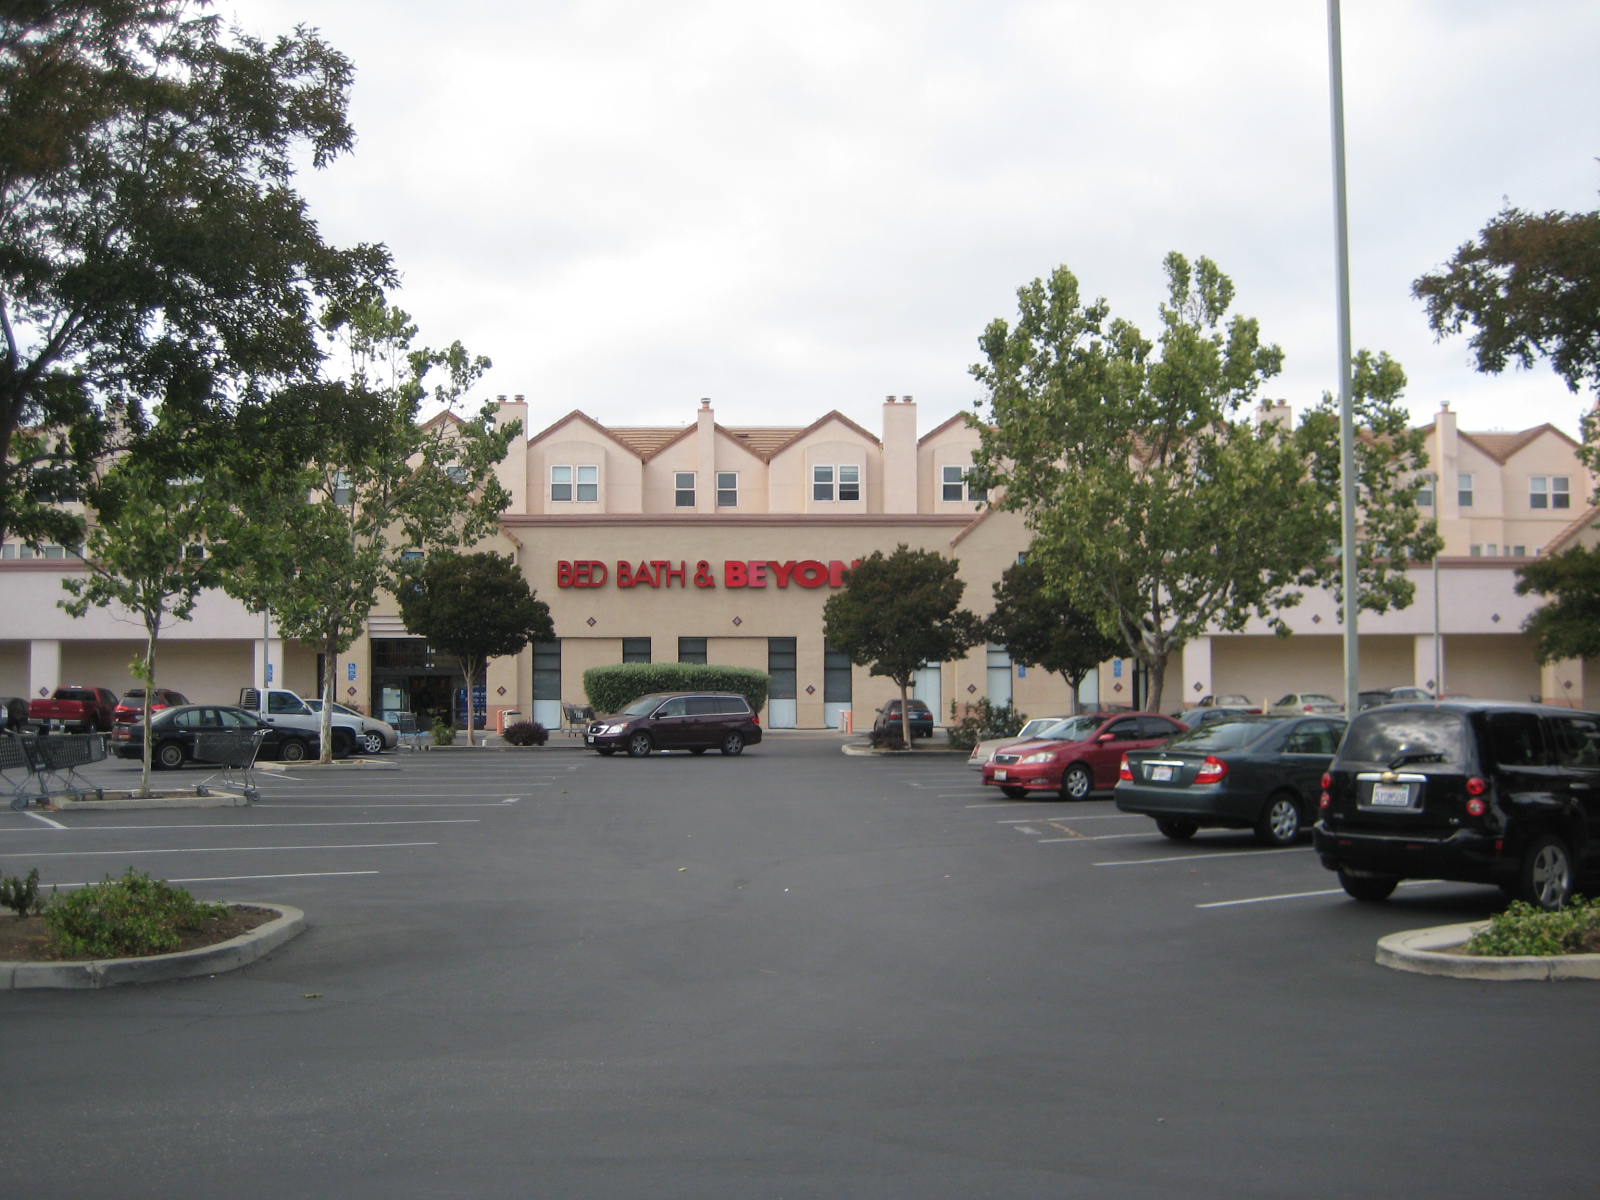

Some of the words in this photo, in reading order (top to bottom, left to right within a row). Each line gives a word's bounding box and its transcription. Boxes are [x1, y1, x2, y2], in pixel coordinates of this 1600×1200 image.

[557, 560, 608, 588] BED
[617, 560, 686, 588] BATH
[694, 560, 716, 588] &
